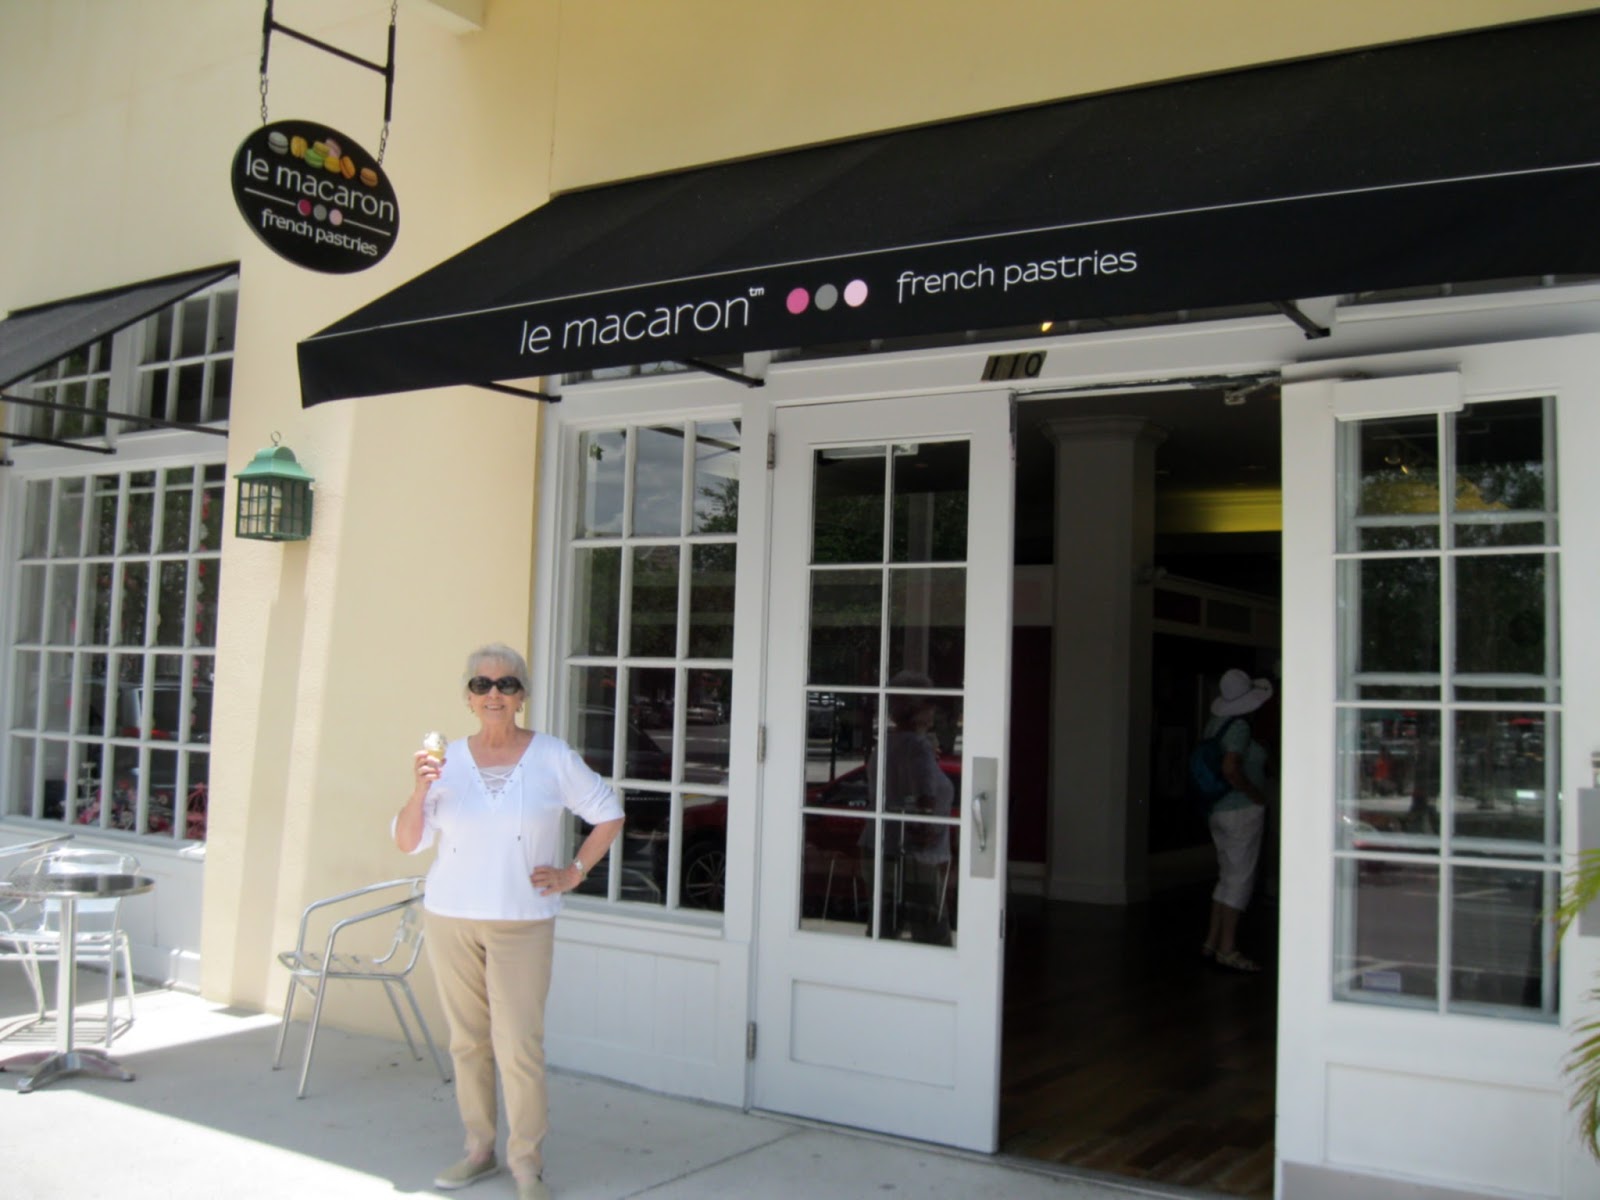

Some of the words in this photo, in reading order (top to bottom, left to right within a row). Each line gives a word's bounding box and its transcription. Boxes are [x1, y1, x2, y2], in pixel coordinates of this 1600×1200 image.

[245, 149, 269, 181] le
[276, 165, 395, 222] macaron
[261, 208, 313, 237] french
[315, 227, 378, 257] pastries
[897, 263, 995, 304] french
[1004, 249, 1138, 291] pastries
[520, 320, 551, 355] le
[989, 352, 1043, 381] 110
